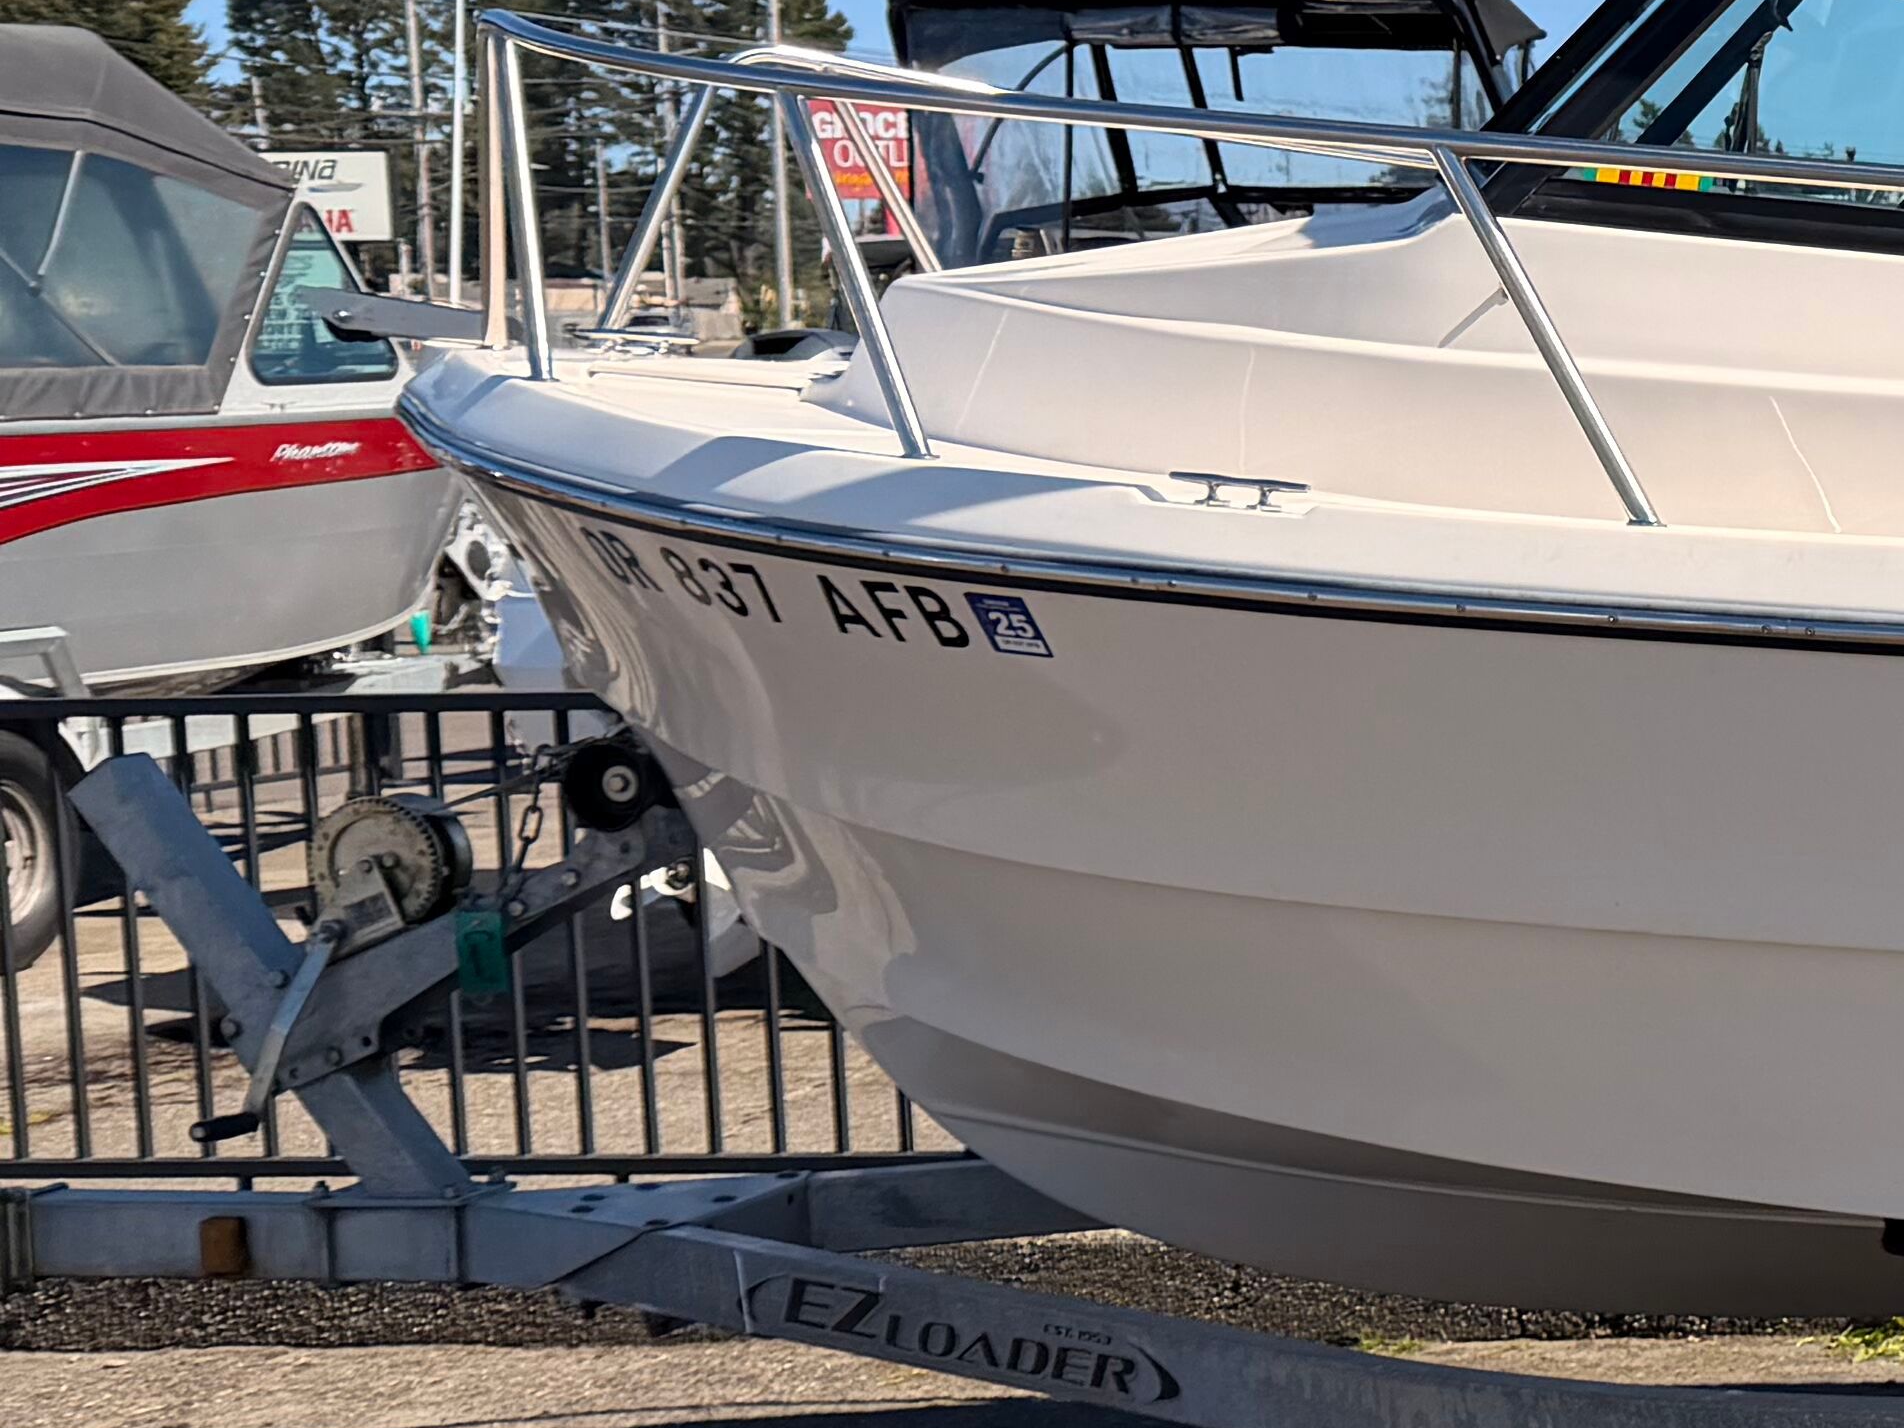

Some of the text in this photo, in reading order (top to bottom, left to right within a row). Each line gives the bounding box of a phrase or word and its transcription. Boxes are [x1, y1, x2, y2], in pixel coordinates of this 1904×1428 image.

[269, 441, 361, 461] Phantom
[580, 527, 970, 649] OR 837 AFB
[988, 611, 1035, 638] 25
[885, 1313, 1136, 1395] LOADER
